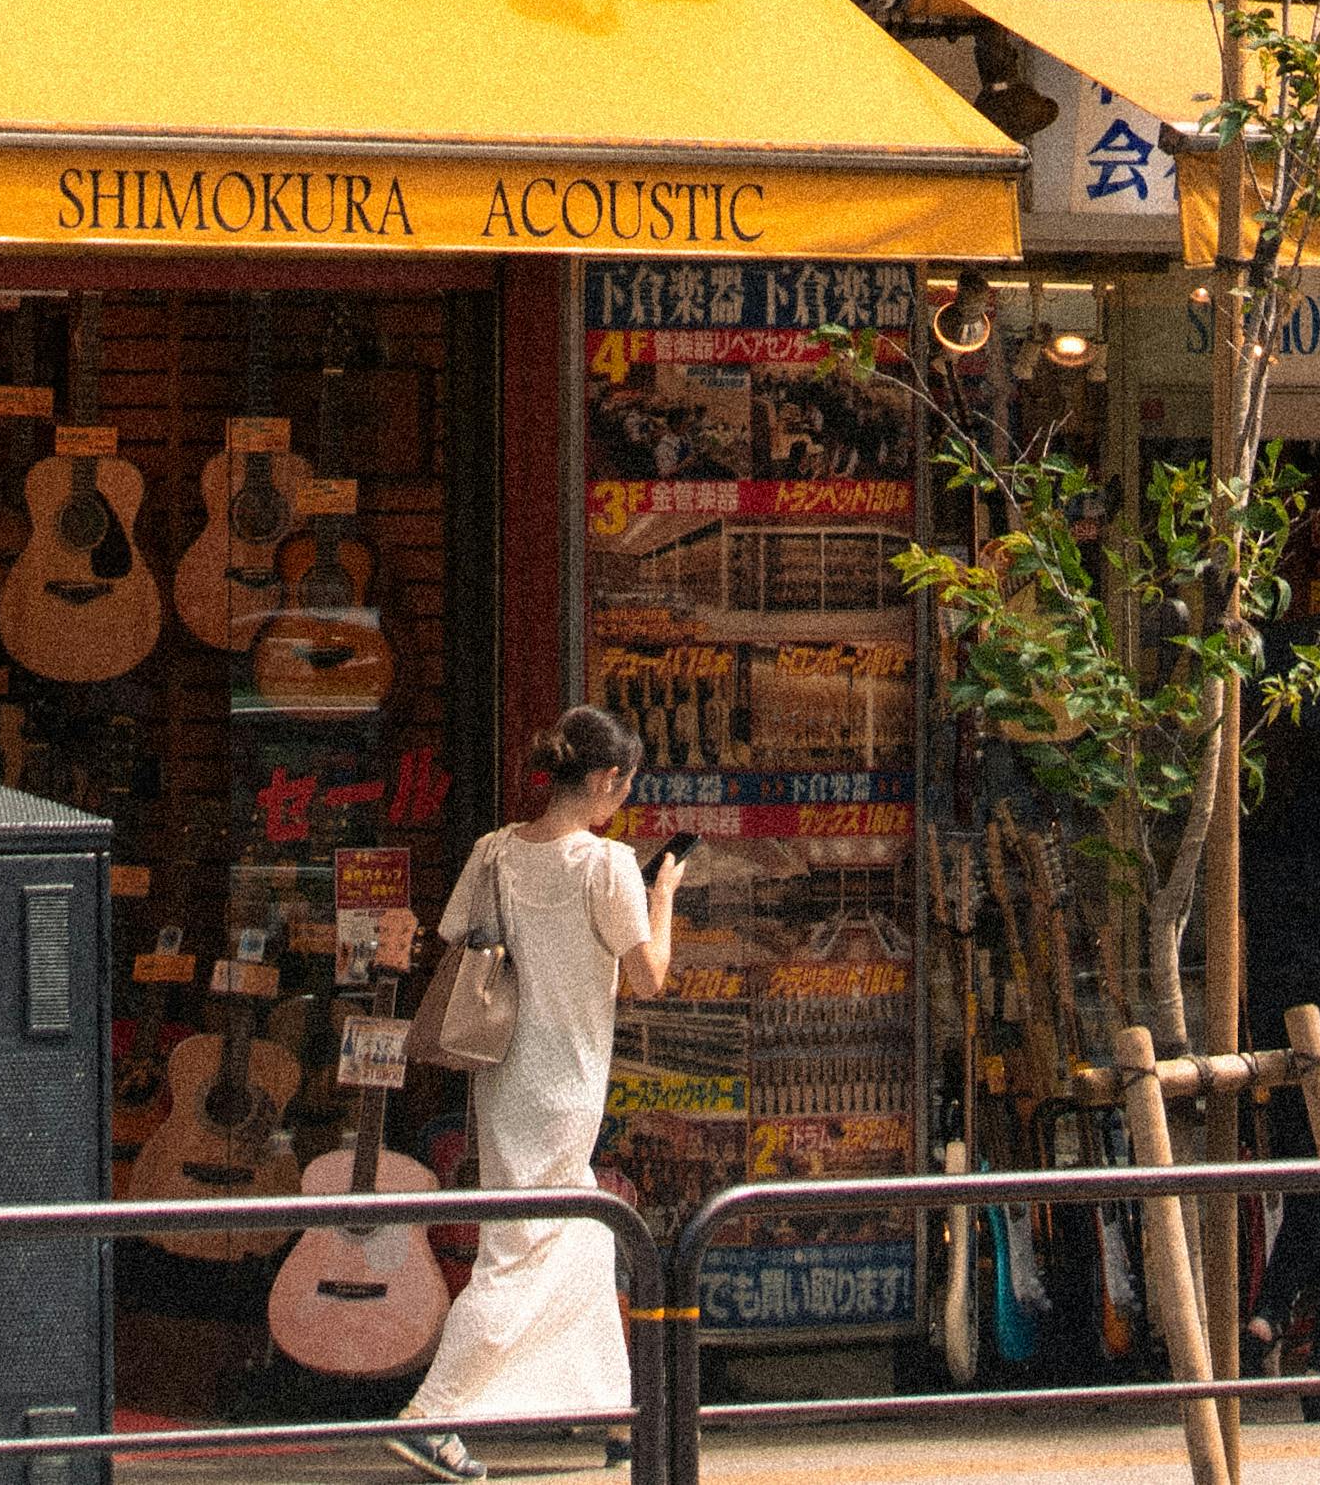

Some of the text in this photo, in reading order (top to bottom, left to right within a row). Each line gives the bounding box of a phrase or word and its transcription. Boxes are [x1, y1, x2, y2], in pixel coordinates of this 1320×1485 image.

[58, 167, 765, 242] SHIMOKURA ACOUSTIC
[256, 747, 452, 843] セール
